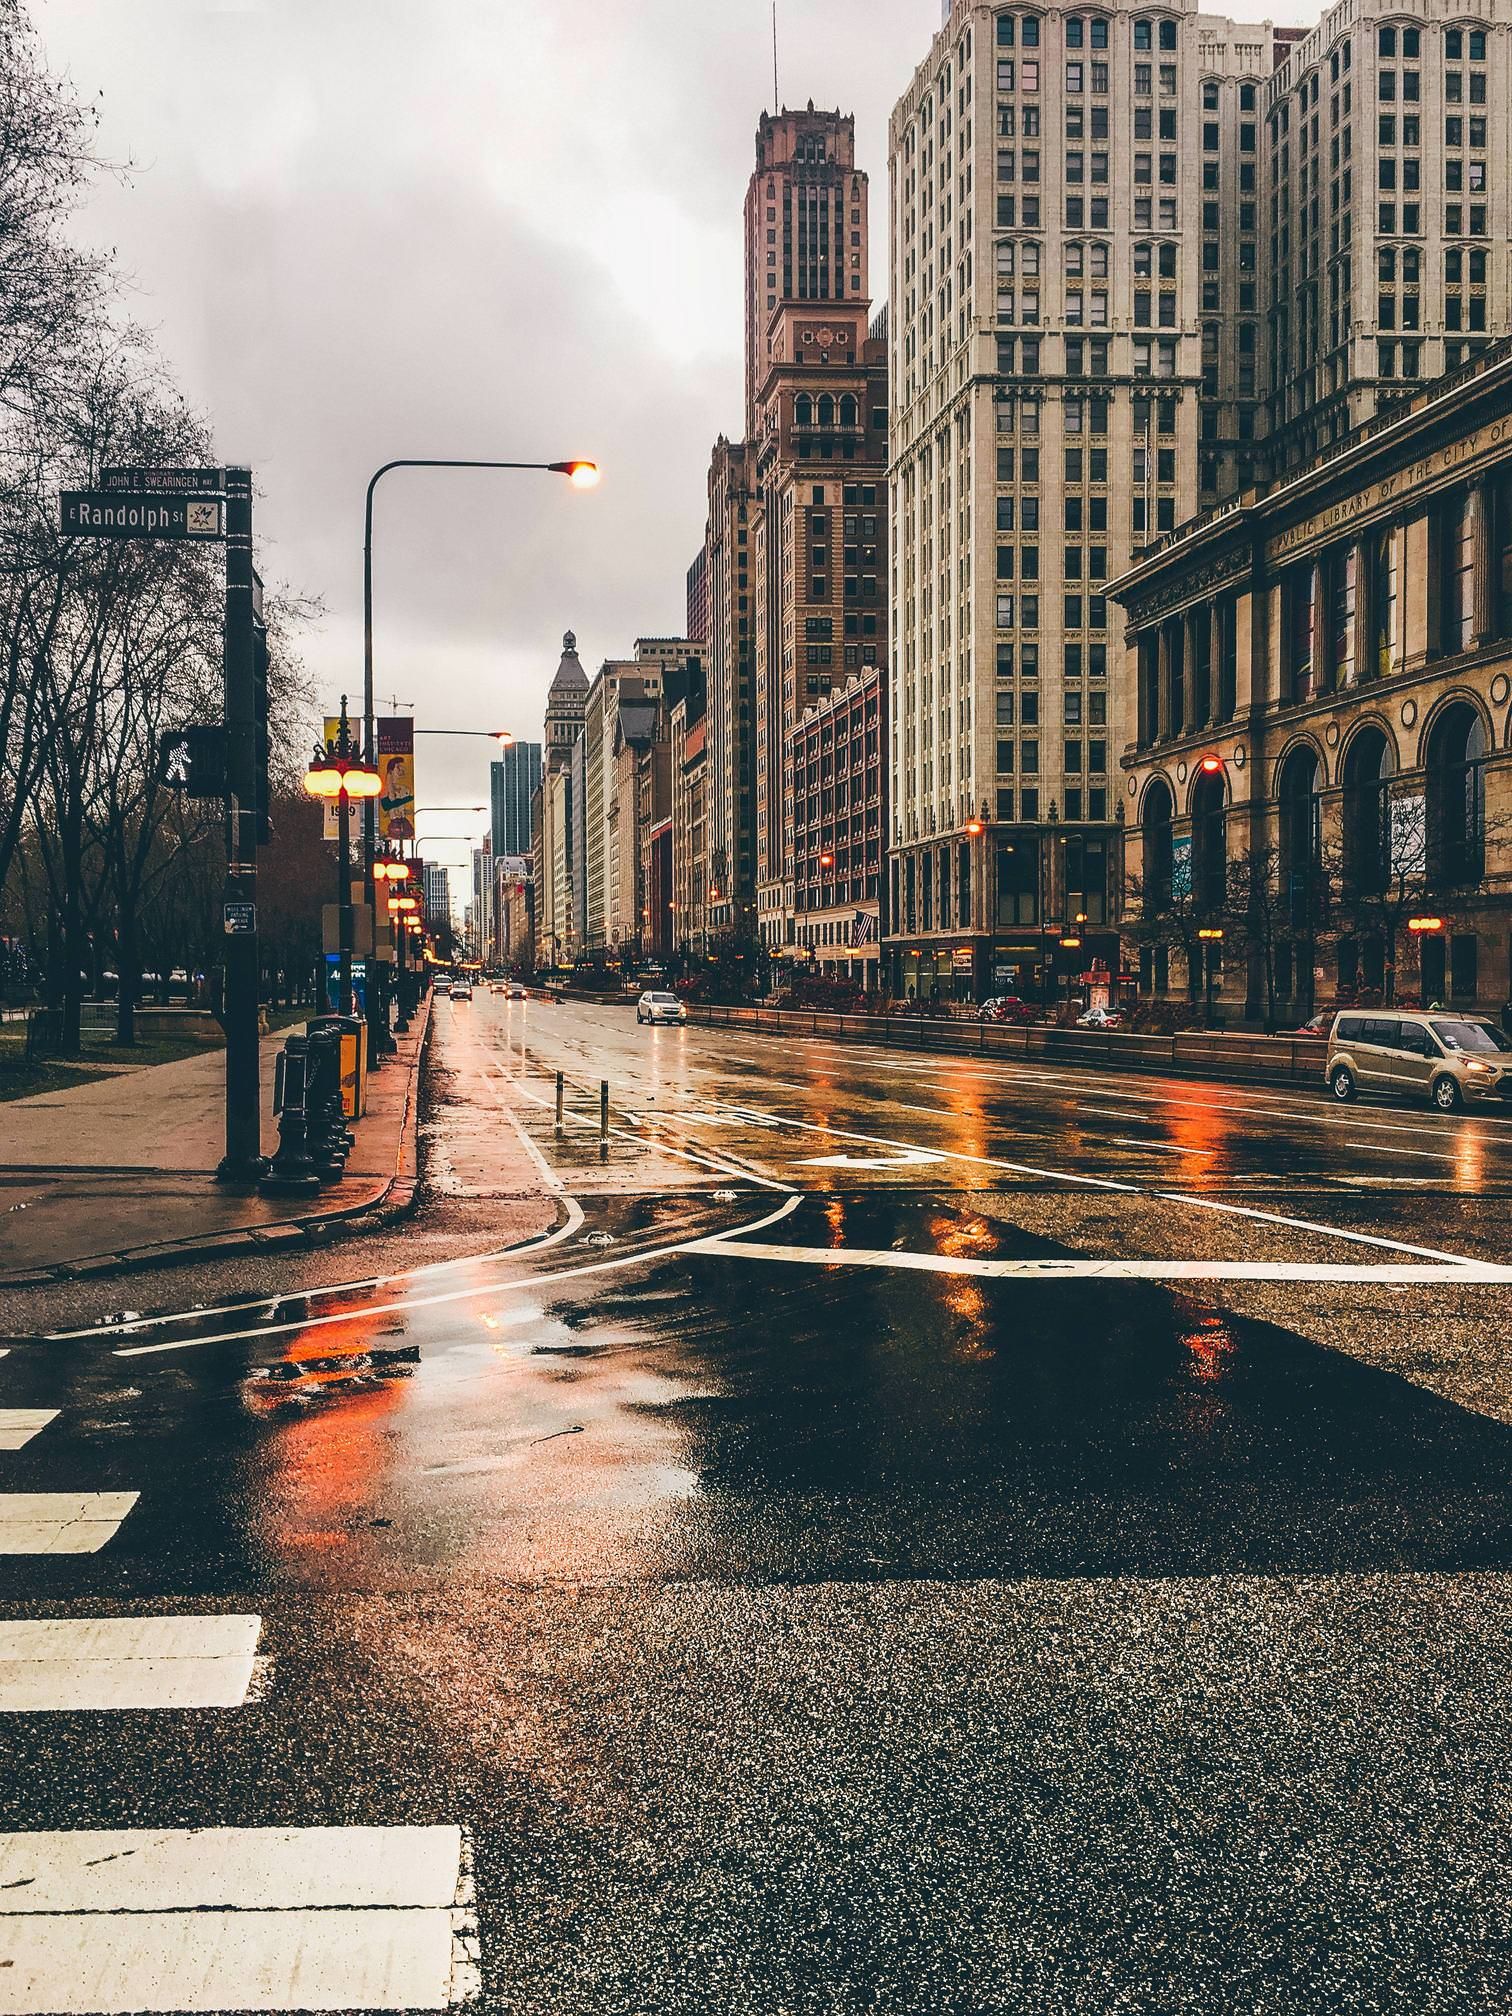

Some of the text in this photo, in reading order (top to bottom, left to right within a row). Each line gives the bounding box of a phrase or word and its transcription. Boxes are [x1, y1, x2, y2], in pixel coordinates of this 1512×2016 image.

[107, 475, 130, 487] JOHN
[133, 475, 142, 487] E.
[144, 476, 199, 488] SWEARINGEN
[1323, 493, 1371, 527] LIBRARY
[1381, 479, 1396, 497] OF
[1407, 461, 1432, 484] THE
[1443, 438, 1478, 465] CITY
[1490, 419, 1509, 441] OF
[69, 503, 184, 531] E Randolph St
[331, 805, 356, 817] 199
